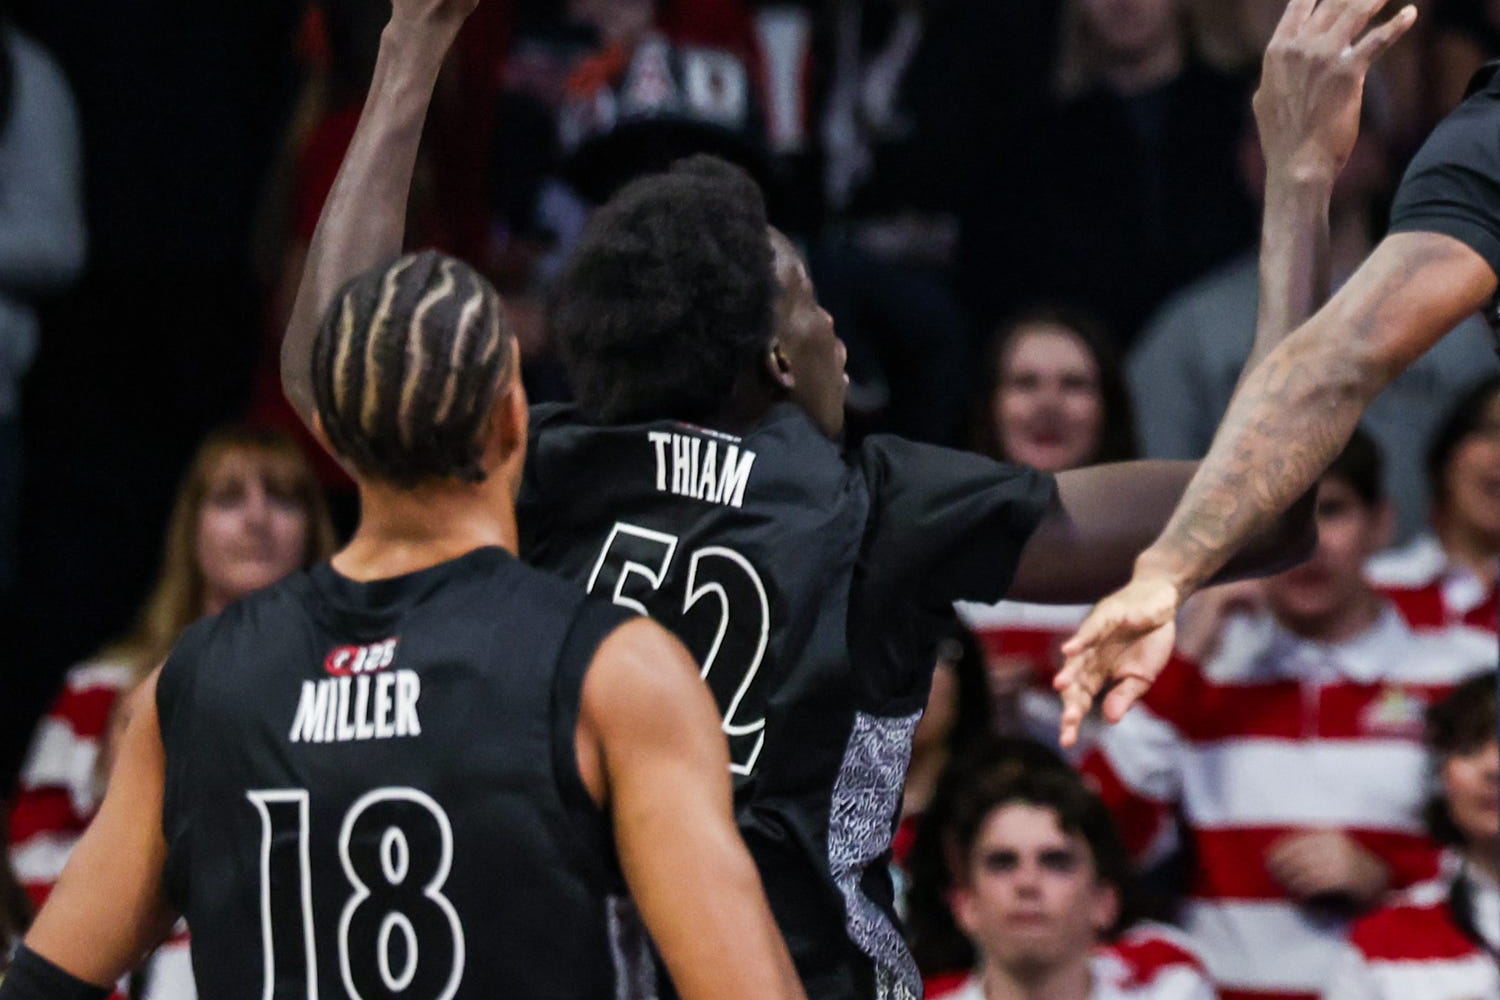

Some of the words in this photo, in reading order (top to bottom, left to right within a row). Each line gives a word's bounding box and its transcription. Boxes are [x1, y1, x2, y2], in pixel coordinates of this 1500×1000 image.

[648, 431, 756, 508] THIAM
[289, 668, 422, 743] MILLER
[246, 786, 466, 1000] 18
